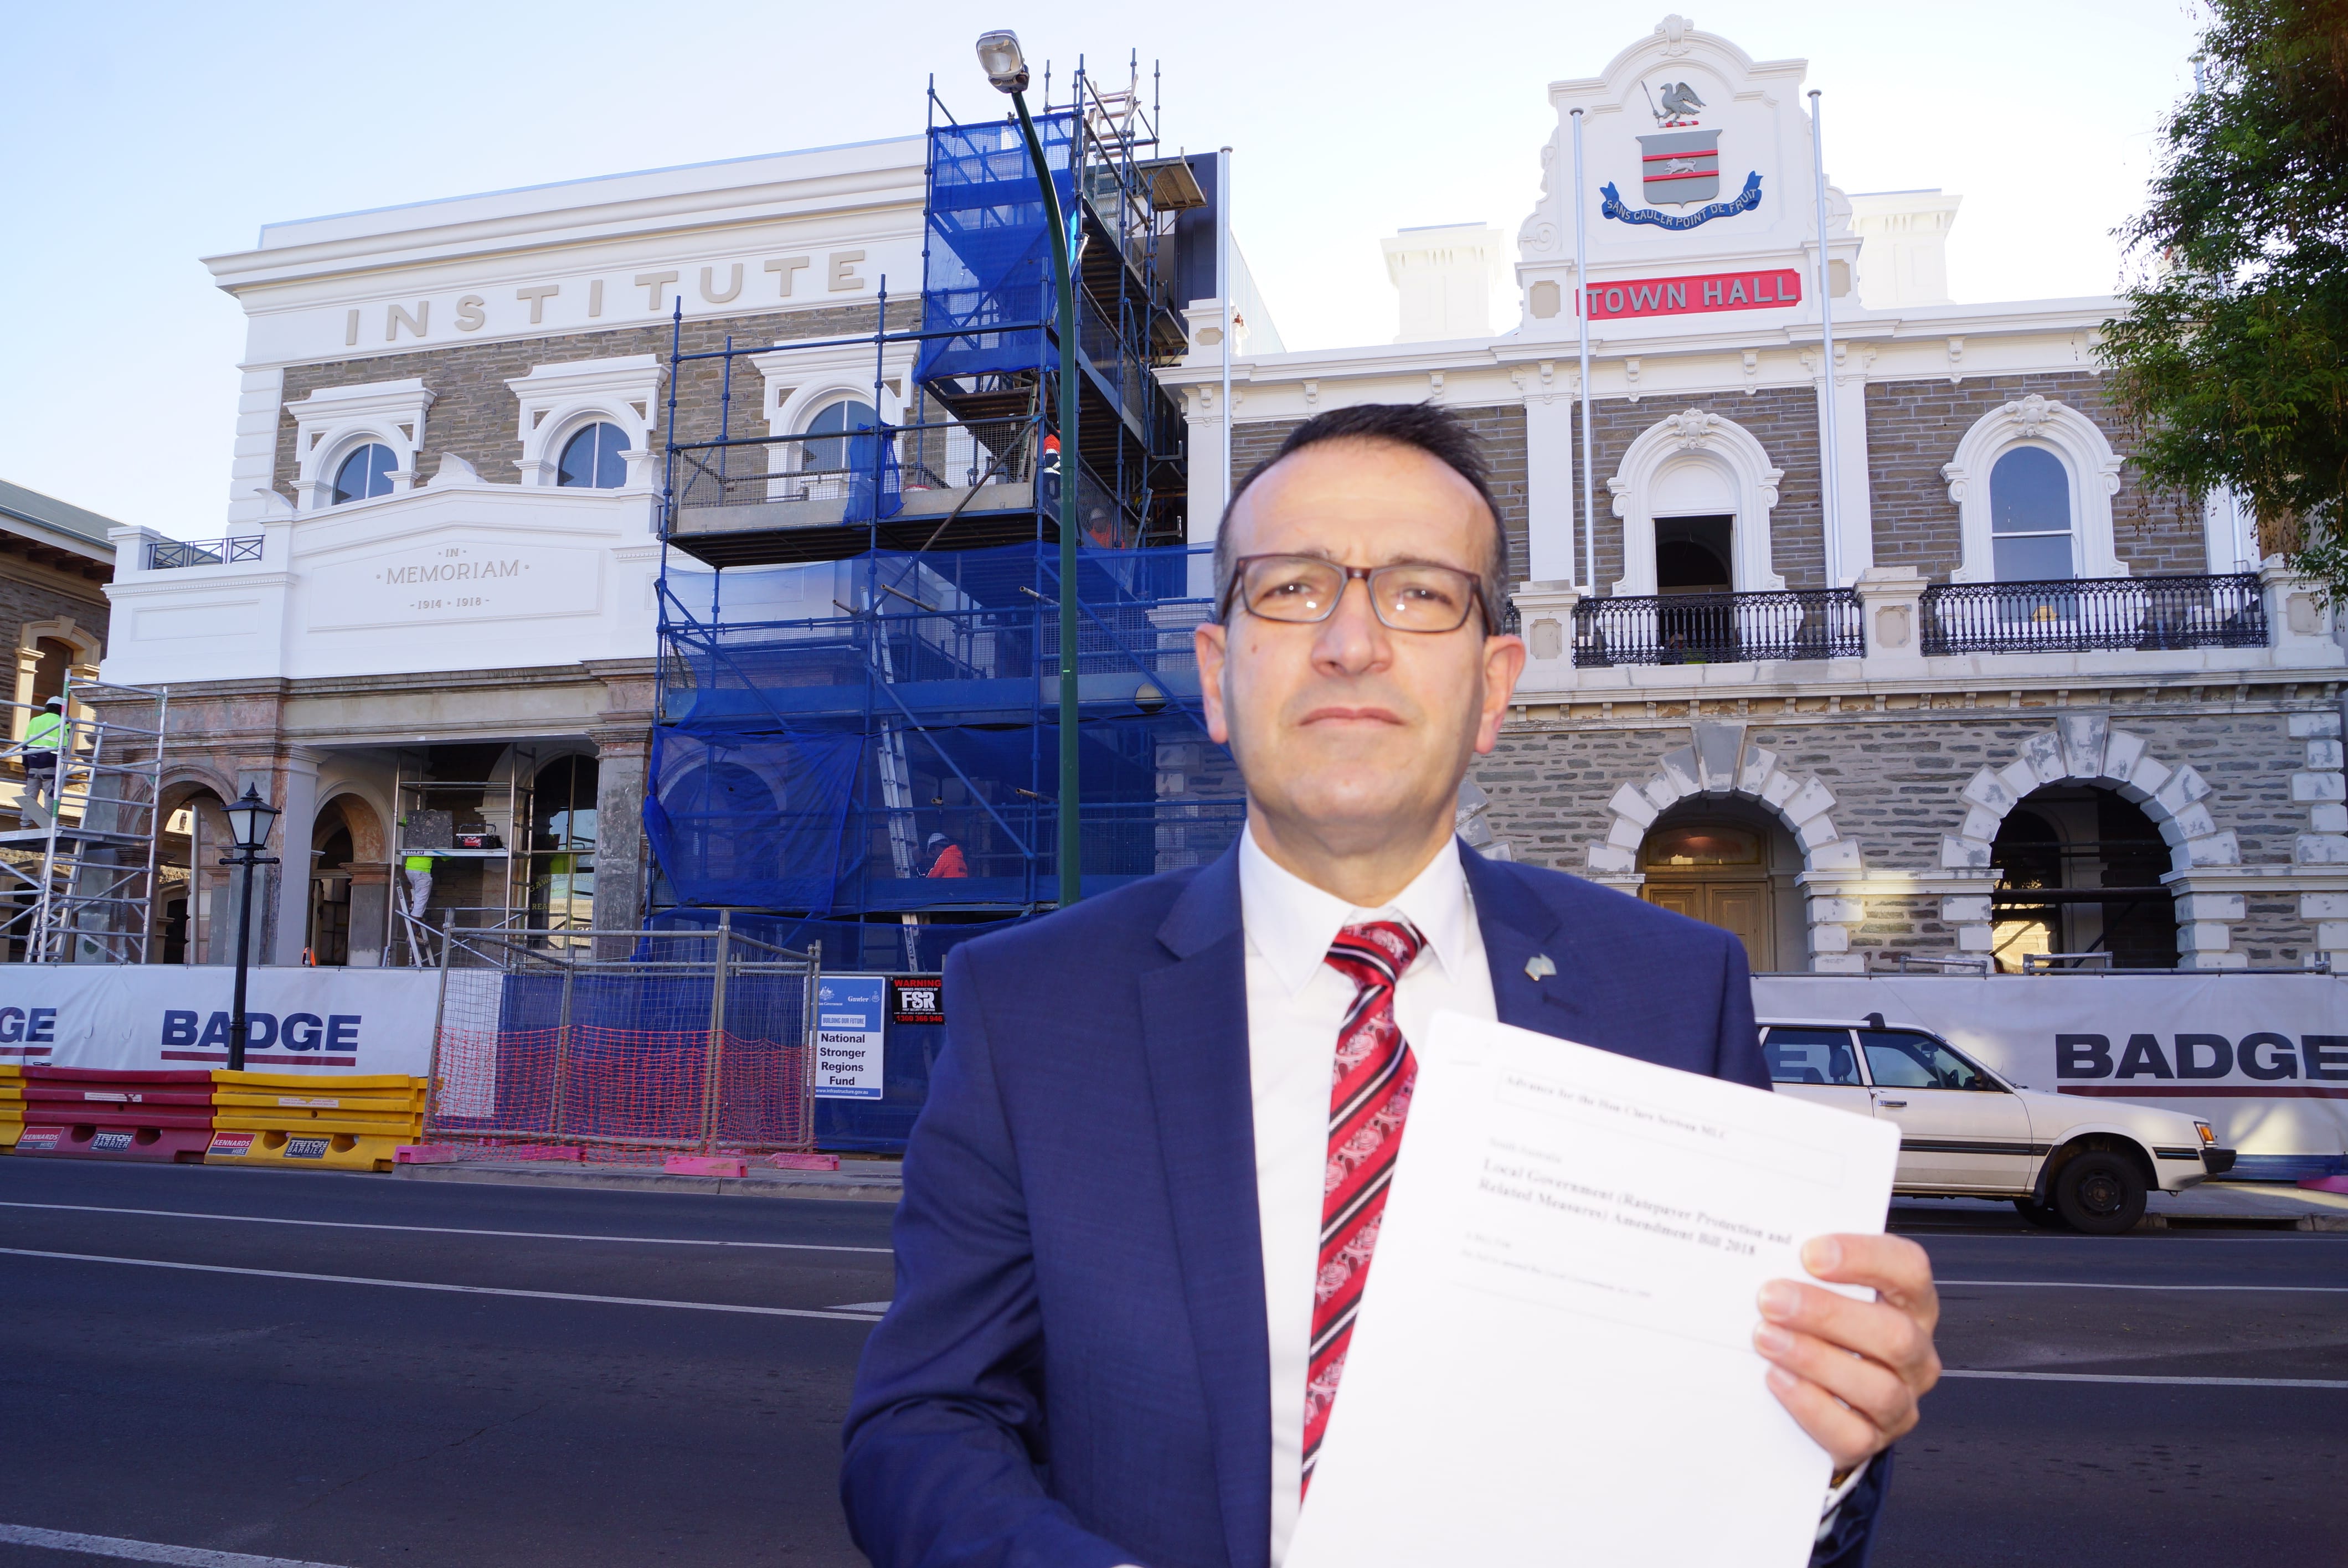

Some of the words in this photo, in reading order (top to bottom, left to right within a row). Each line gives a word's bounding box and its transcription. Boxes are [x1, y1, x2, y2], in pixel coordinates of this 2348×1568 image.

[1607, 200, 1631, 220] SANS
[1634, 210, 1673, 226] CAULER
[1676, 210, 1707, 228] POINT
[1710, 204, 1725, 214] DE
[1729, 189, 1757, 213] FRUIT
[346, 250, 864, 345] INSTITUTE
[1587, 283, 1686, 314] TOWN
[1703, 276, 1796, 307] HALL
[445, 548, 459, 558] IN
[386, 559, 519, 584] MEMORIAM
[902, 992, 935, 1008] FSR
[161, 1010, 362, 1052] BADGE
[821, 1033, 865, 1043] National
[820, 1048, 866, 1059] Stronger
[821, 1061, 864, 1073] Regions
[2056, 1033, 2348, 1080] BADGE
[830, 1076, 855, 1085] Fund
[1478, 1177, 1532, 1201] Related
[1615, 1212, 1693, 1240] Amendment
[1484, 1157, 1524, 1177] Local
[1527, 1169, 1613, 1200] Government
[1696, 1211, 1763, 1238] Protection
[1768, 1232, 1793, 1245] and
